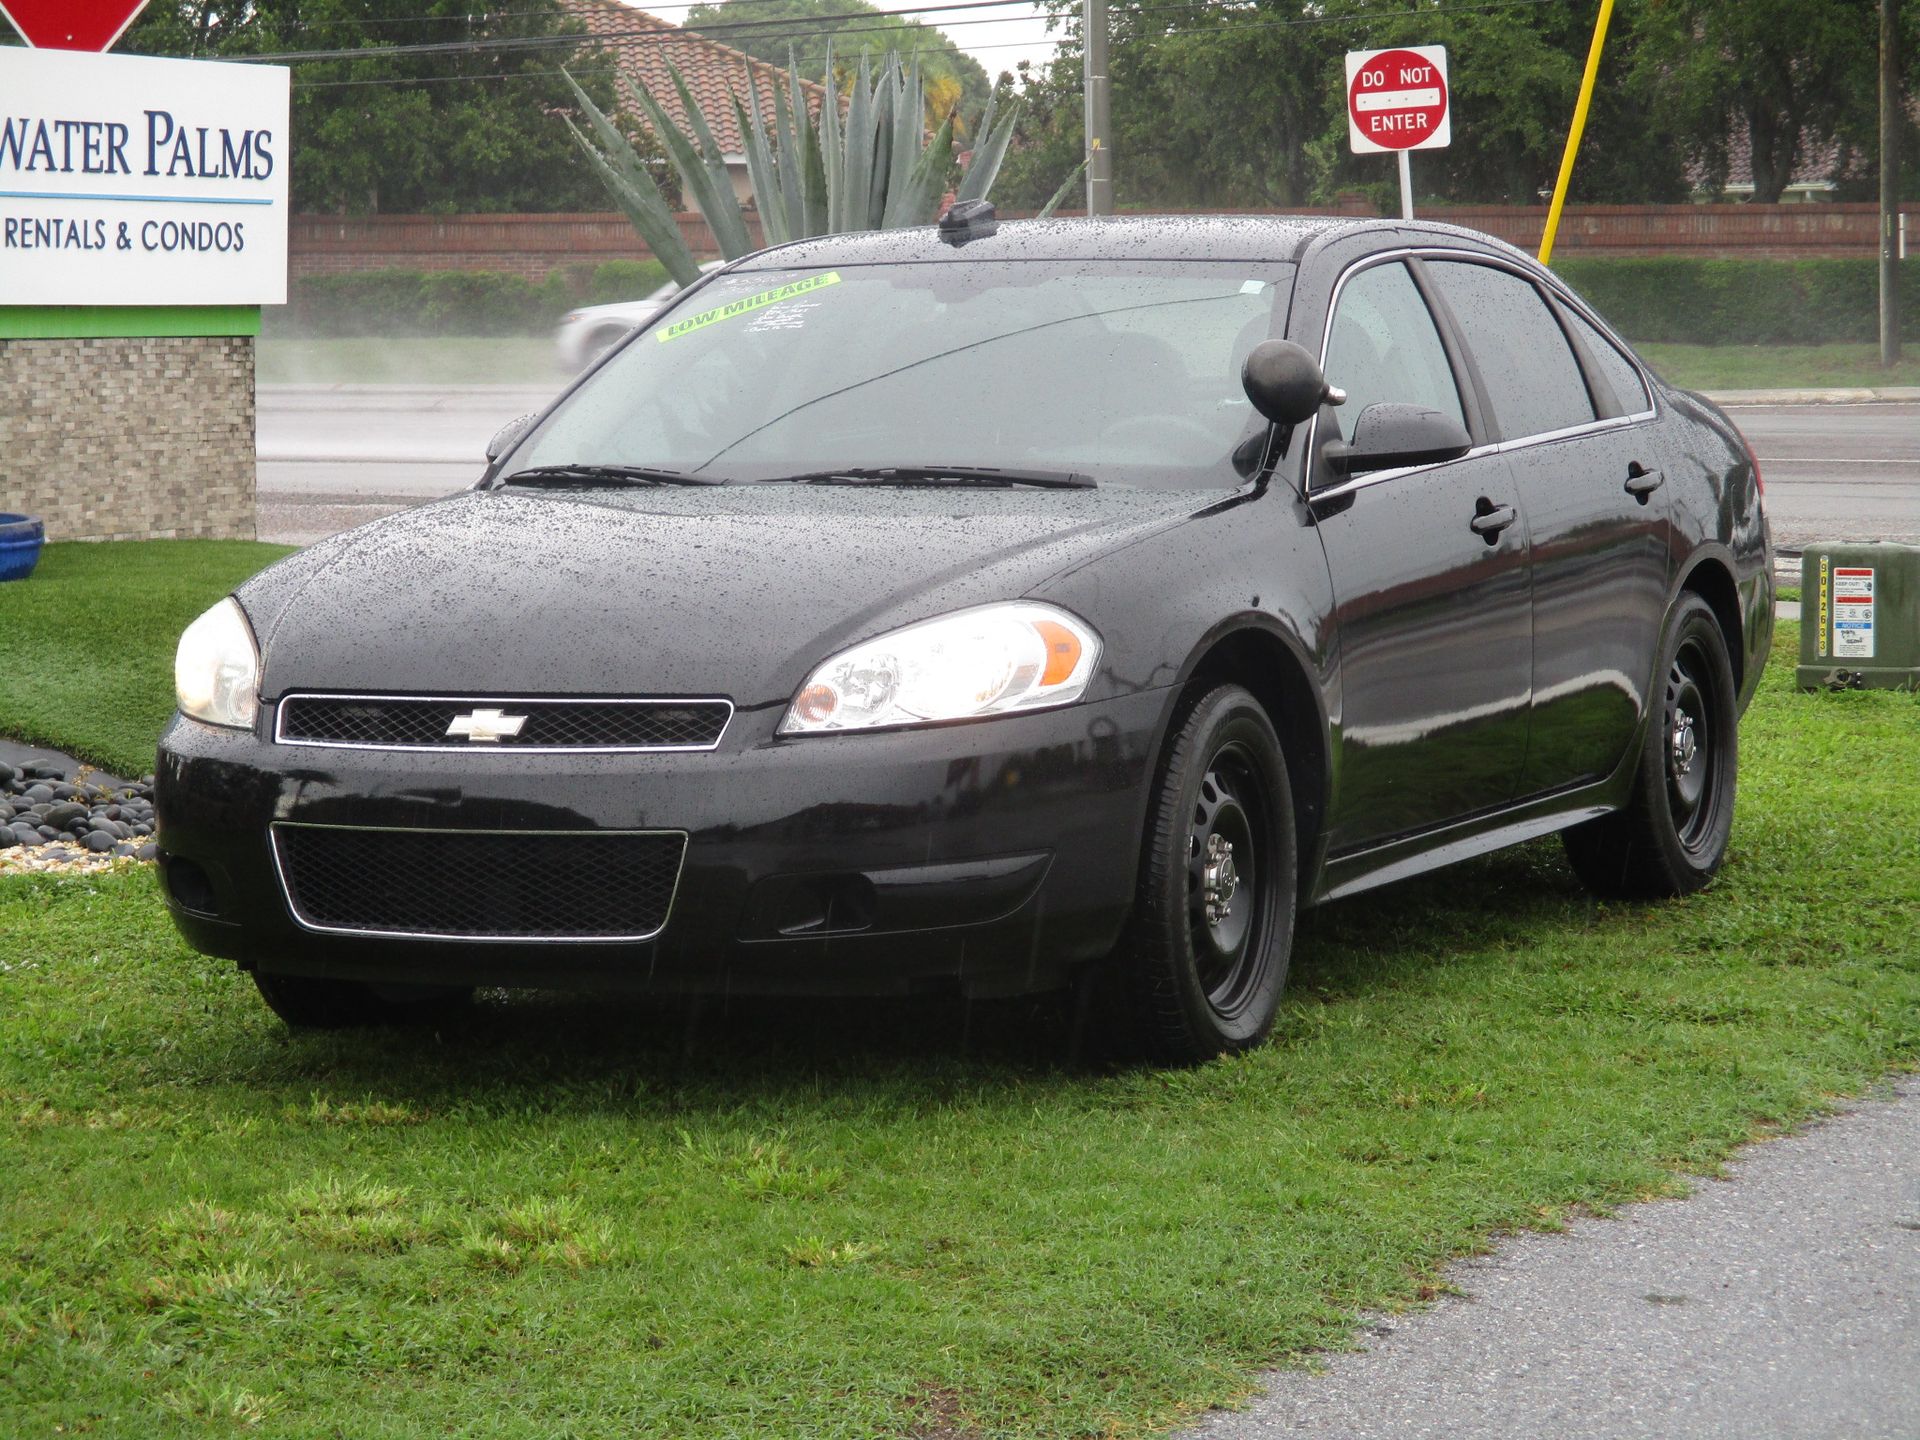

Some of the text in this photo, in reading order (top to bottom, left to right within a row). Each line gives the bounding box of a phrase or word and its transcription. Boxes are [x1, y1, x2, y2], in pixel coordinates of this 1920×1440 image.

[1363, 67, 1431, 87] DO NOT
[1371, 113, 1427, 132] ENTER
[0, 117, 131, 174] WATER
[5, 217, 244, 251] RENTALS & CONDOS
[667, 310, 716, 337] LOW
[723, 274, 827, 316] MILEAGE
